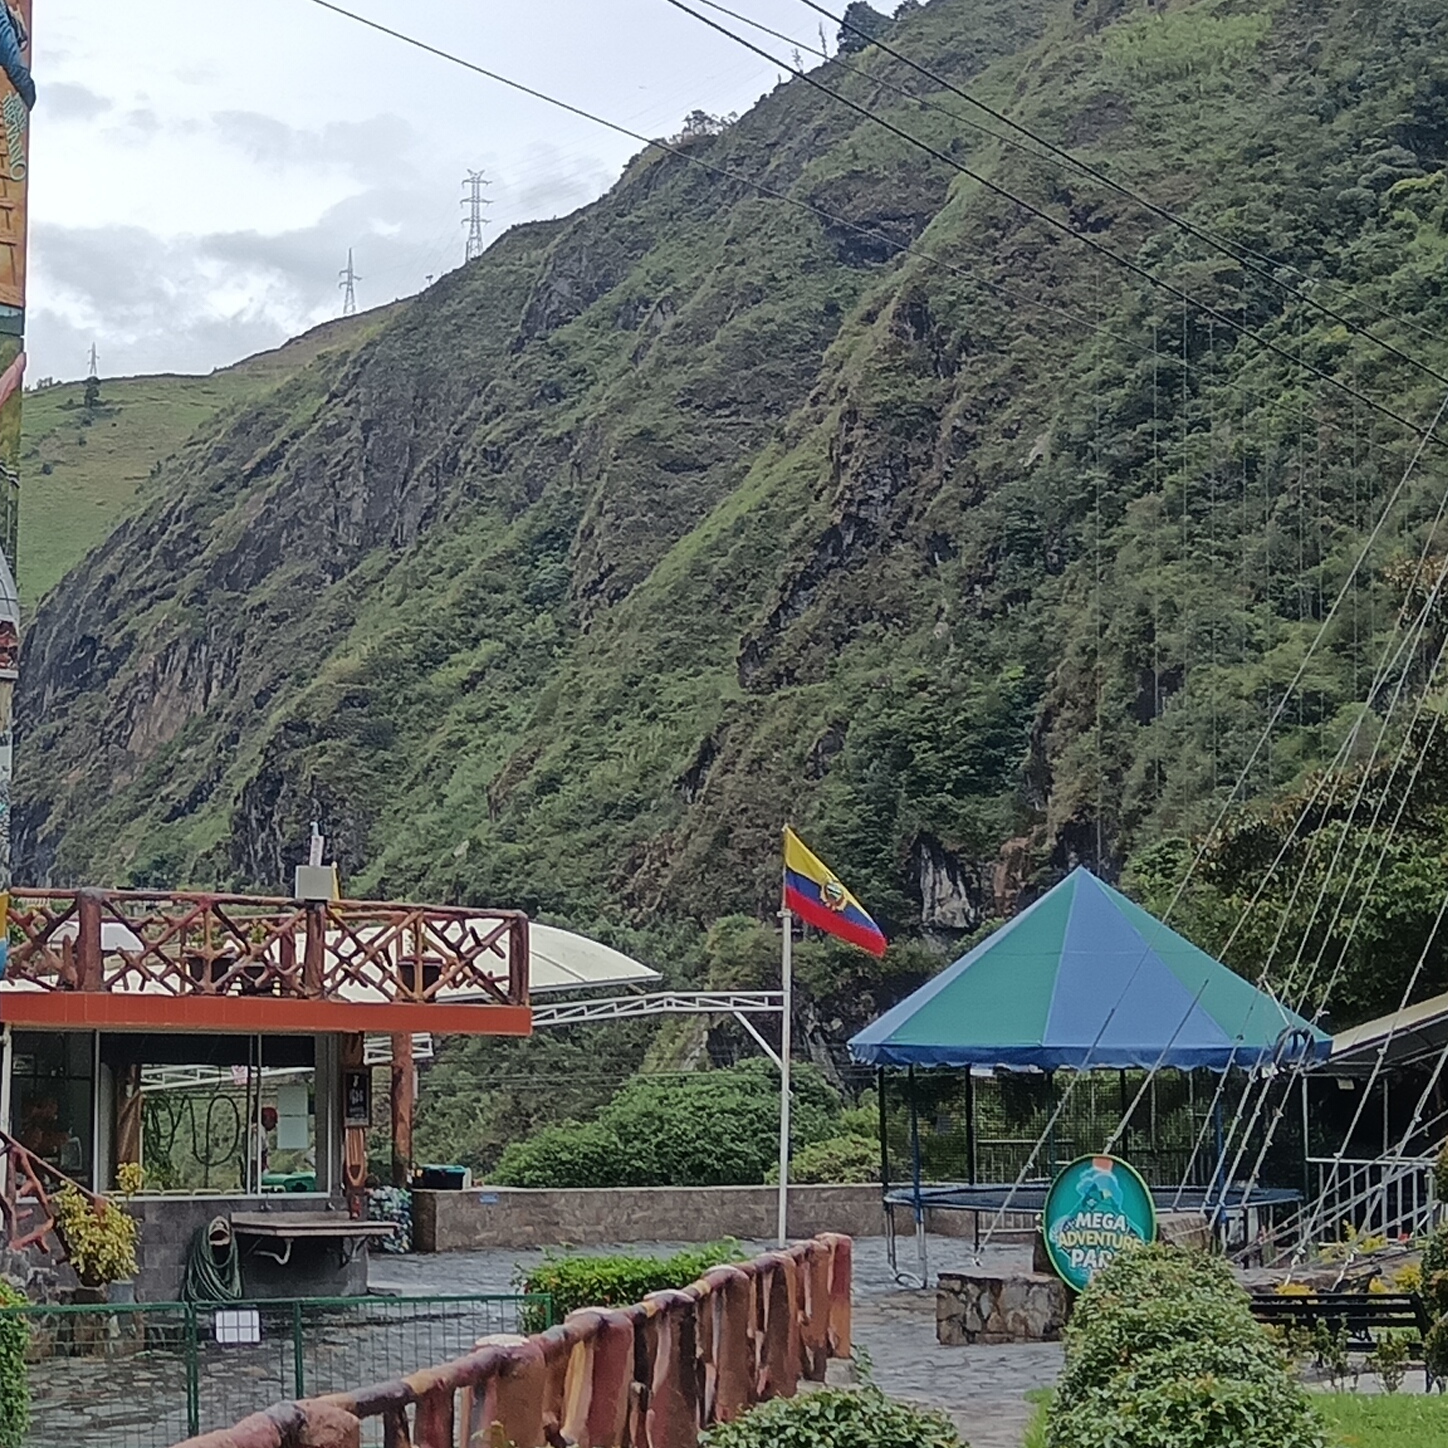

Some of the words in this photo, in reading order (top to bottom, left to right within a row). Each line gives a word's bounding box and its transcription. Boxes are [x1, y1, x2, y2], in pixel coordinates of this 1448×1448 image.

[1075, 1212, 1126, 1231] MEGA
[1058, 1230, 1144, 1250] ADVENTURE
[1071, 1249, 1114, 1268] PAR
